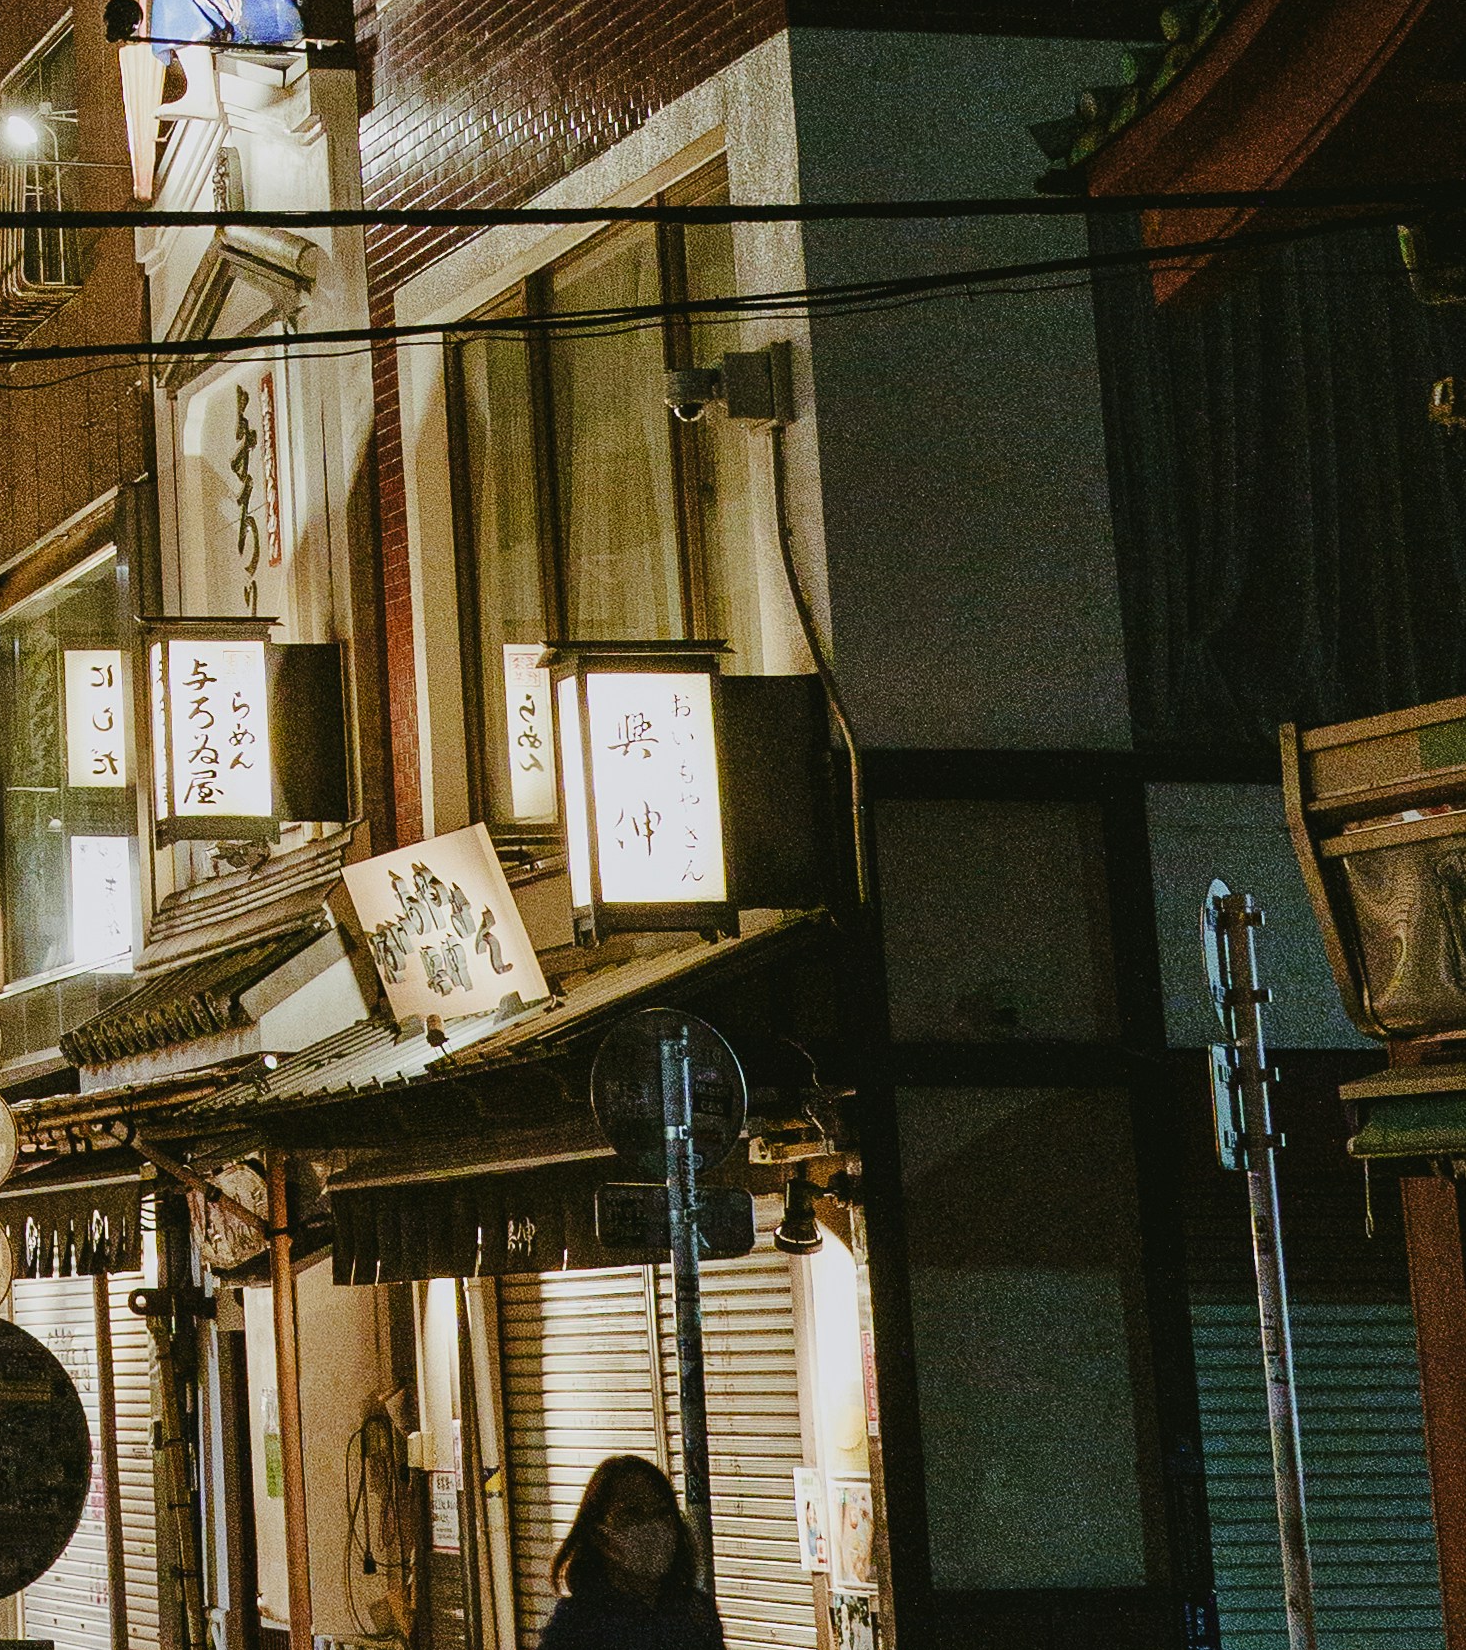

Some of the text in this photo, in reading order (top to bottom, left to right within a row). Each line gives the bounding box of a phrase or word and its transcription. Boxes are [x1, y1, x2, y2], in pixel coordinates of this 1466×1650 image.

[228, 691, 256, 770] らめん
[670, 693, 705, 883] おいもやさん
